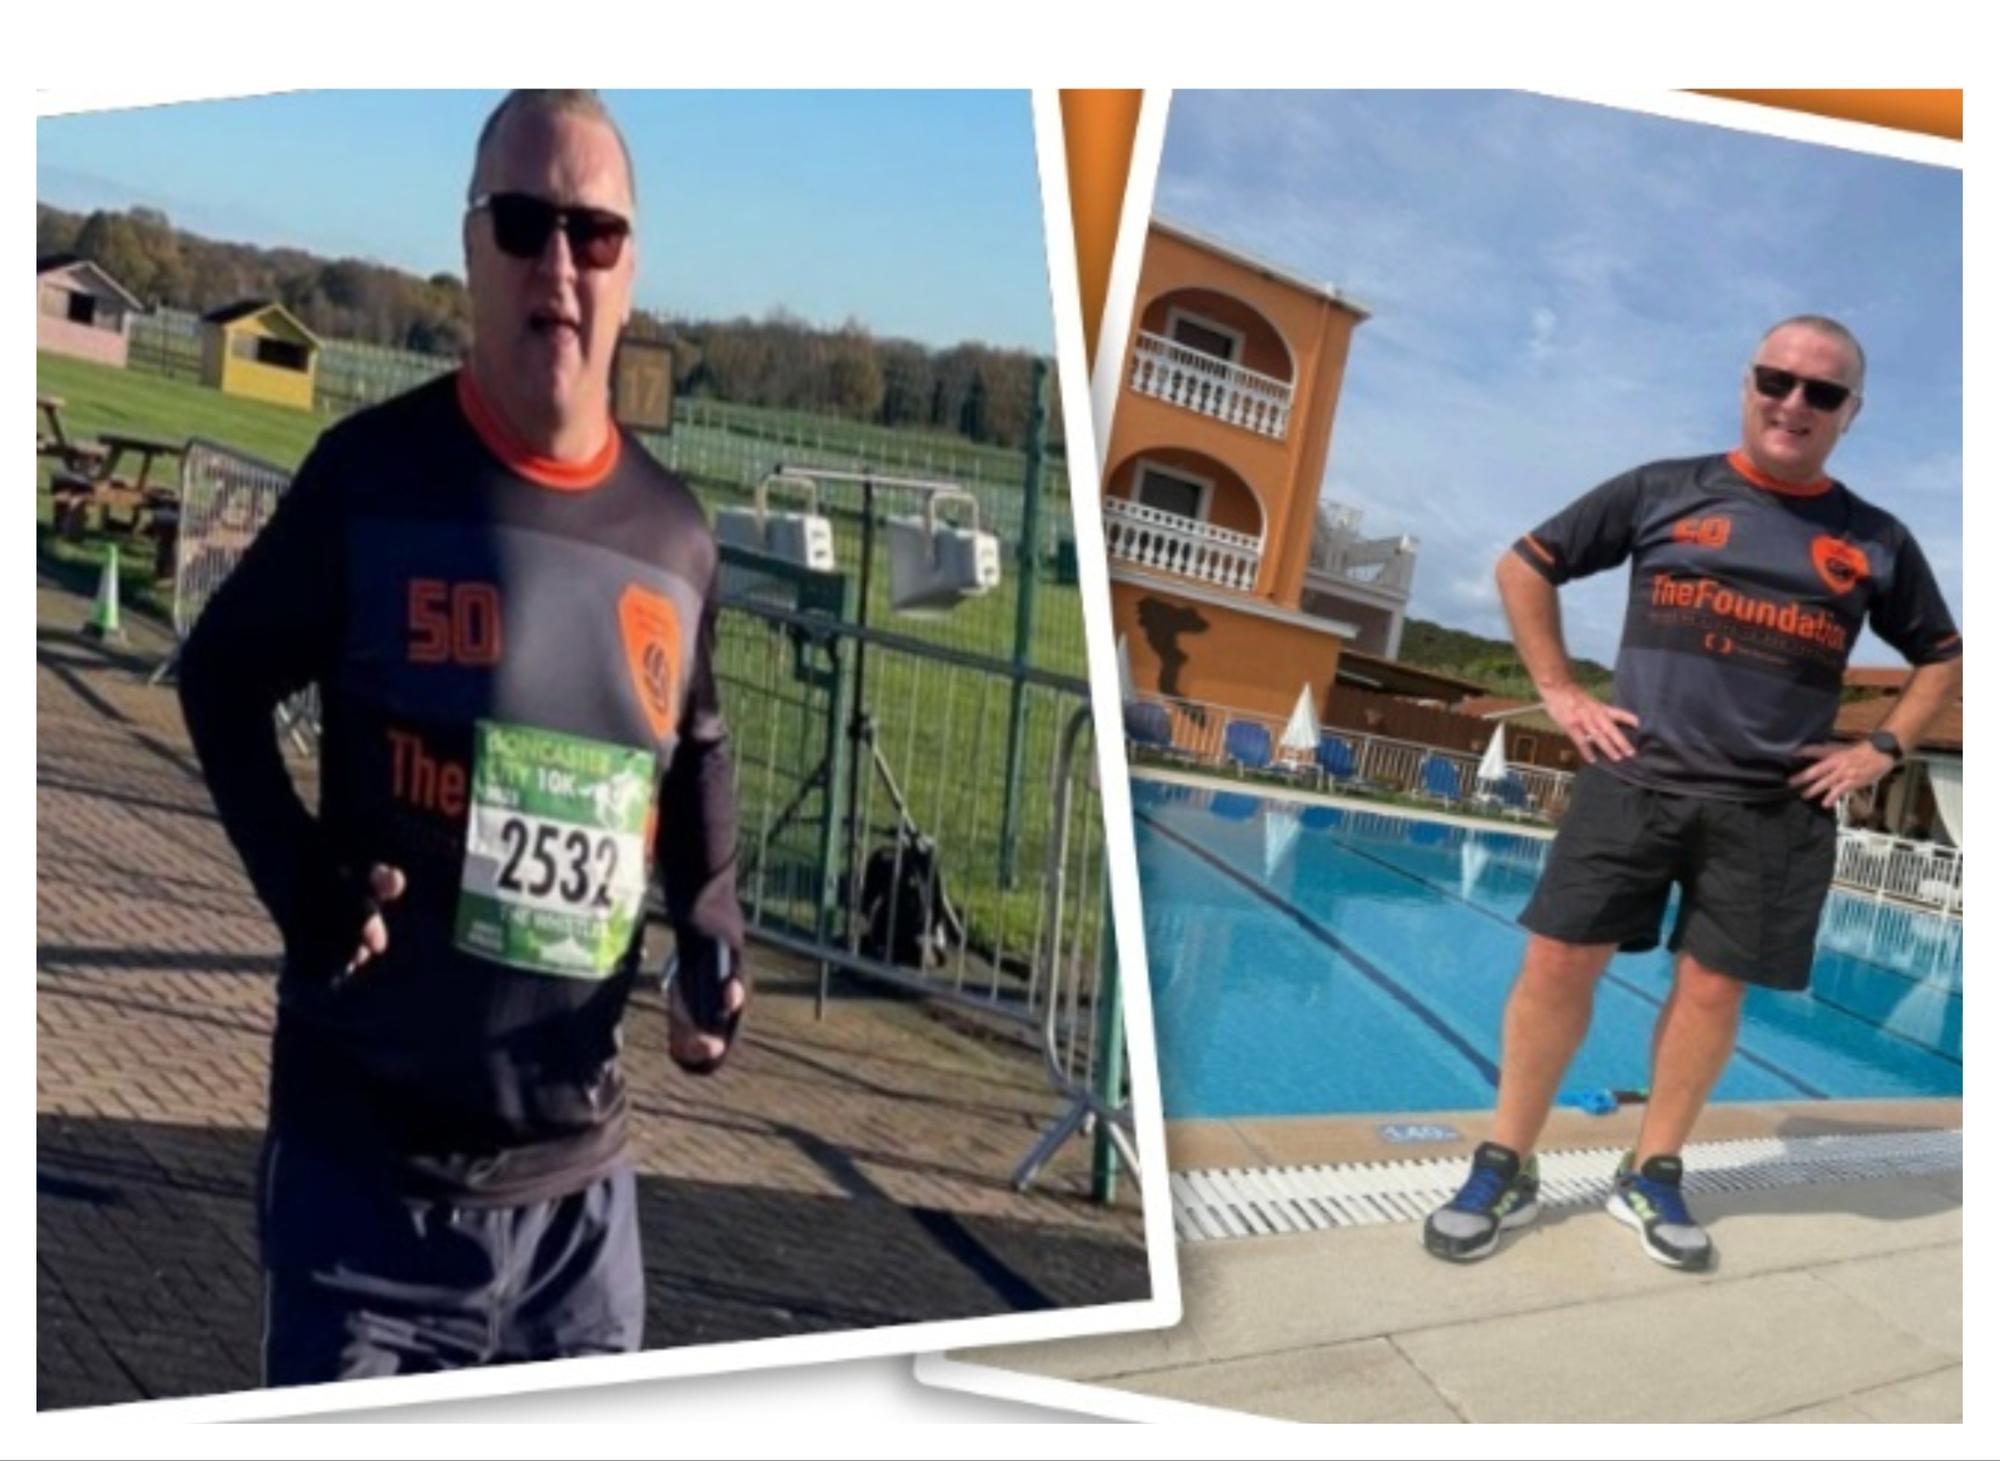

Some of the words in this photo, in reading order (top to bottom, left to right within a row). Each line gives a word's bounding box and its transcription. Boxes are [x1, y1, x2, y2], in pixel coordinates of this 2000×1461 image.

[408, 579, 503, 664] 50
[537, 767, 576, 797] 10K
[497, 817, 619, 909] 2532
